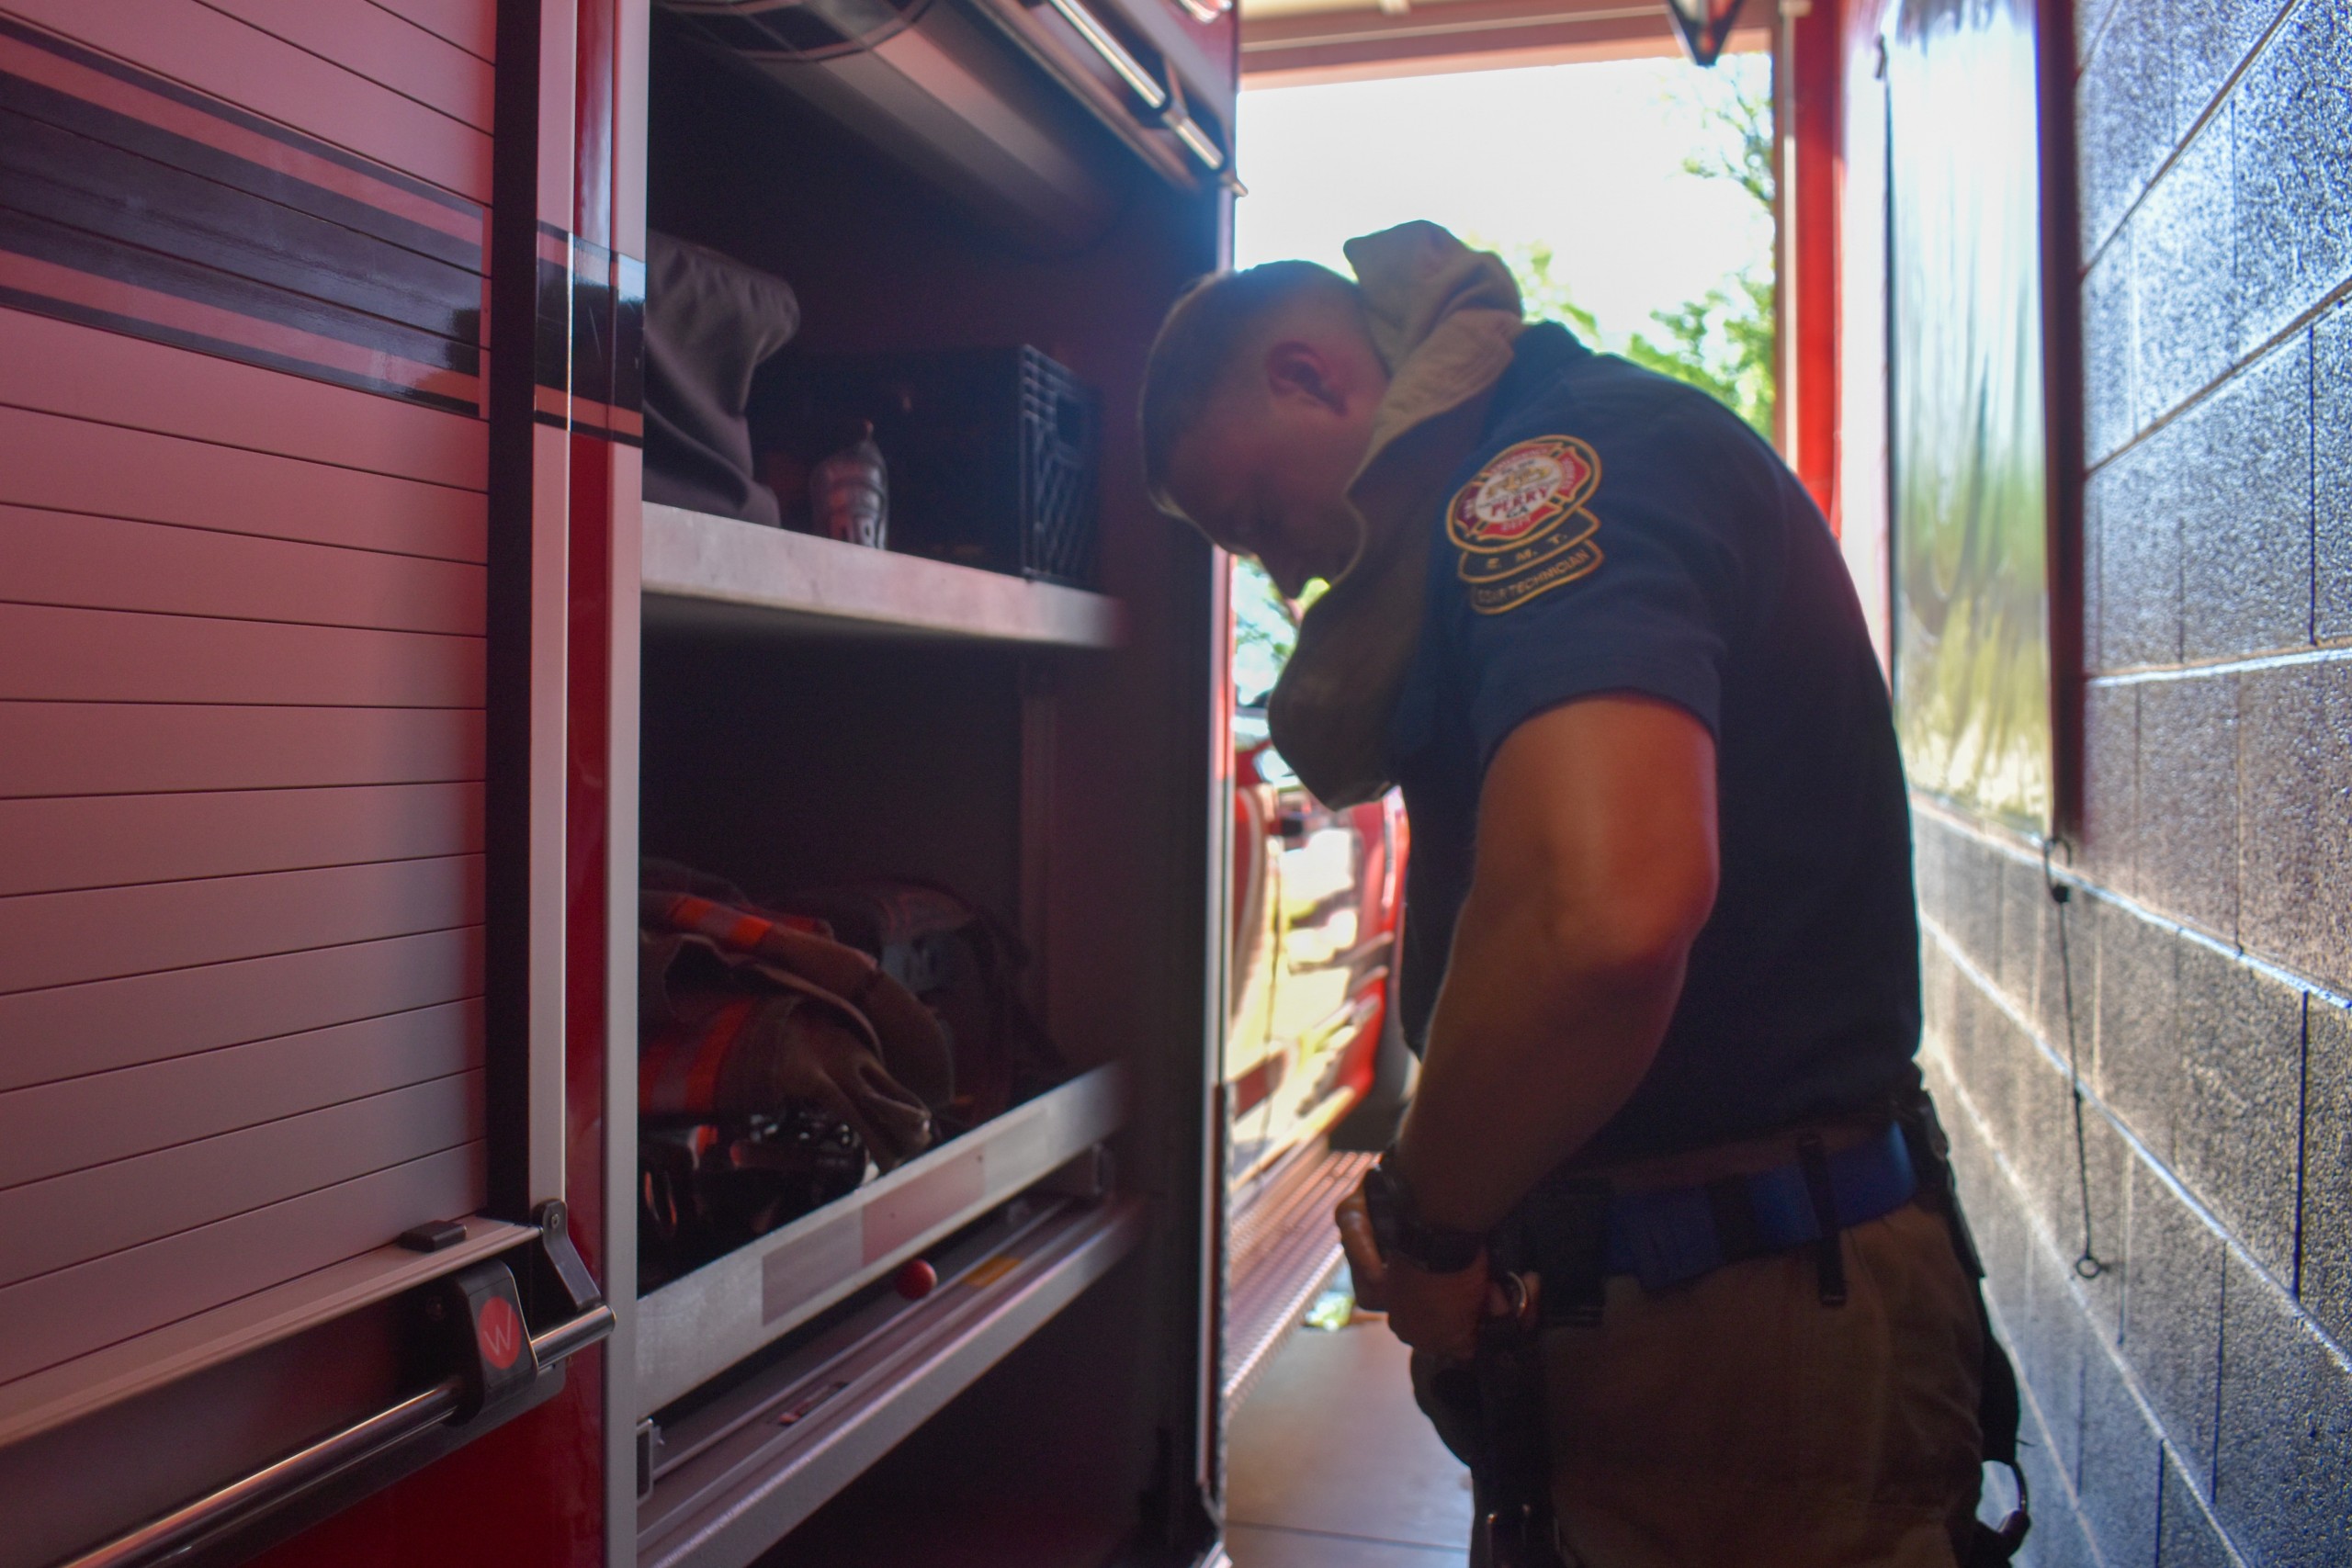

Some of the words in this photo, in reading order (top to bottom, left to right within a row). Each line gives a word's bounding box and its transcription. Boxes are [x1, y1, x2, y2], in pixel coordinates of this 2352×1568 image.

[1491, 487, 1550, 516] PERRY
[1507, 505, 1530, 519] GA
[1507, 548, 1590, 594] TECHNICIAN
[484, 1303, 515, 1357] W
